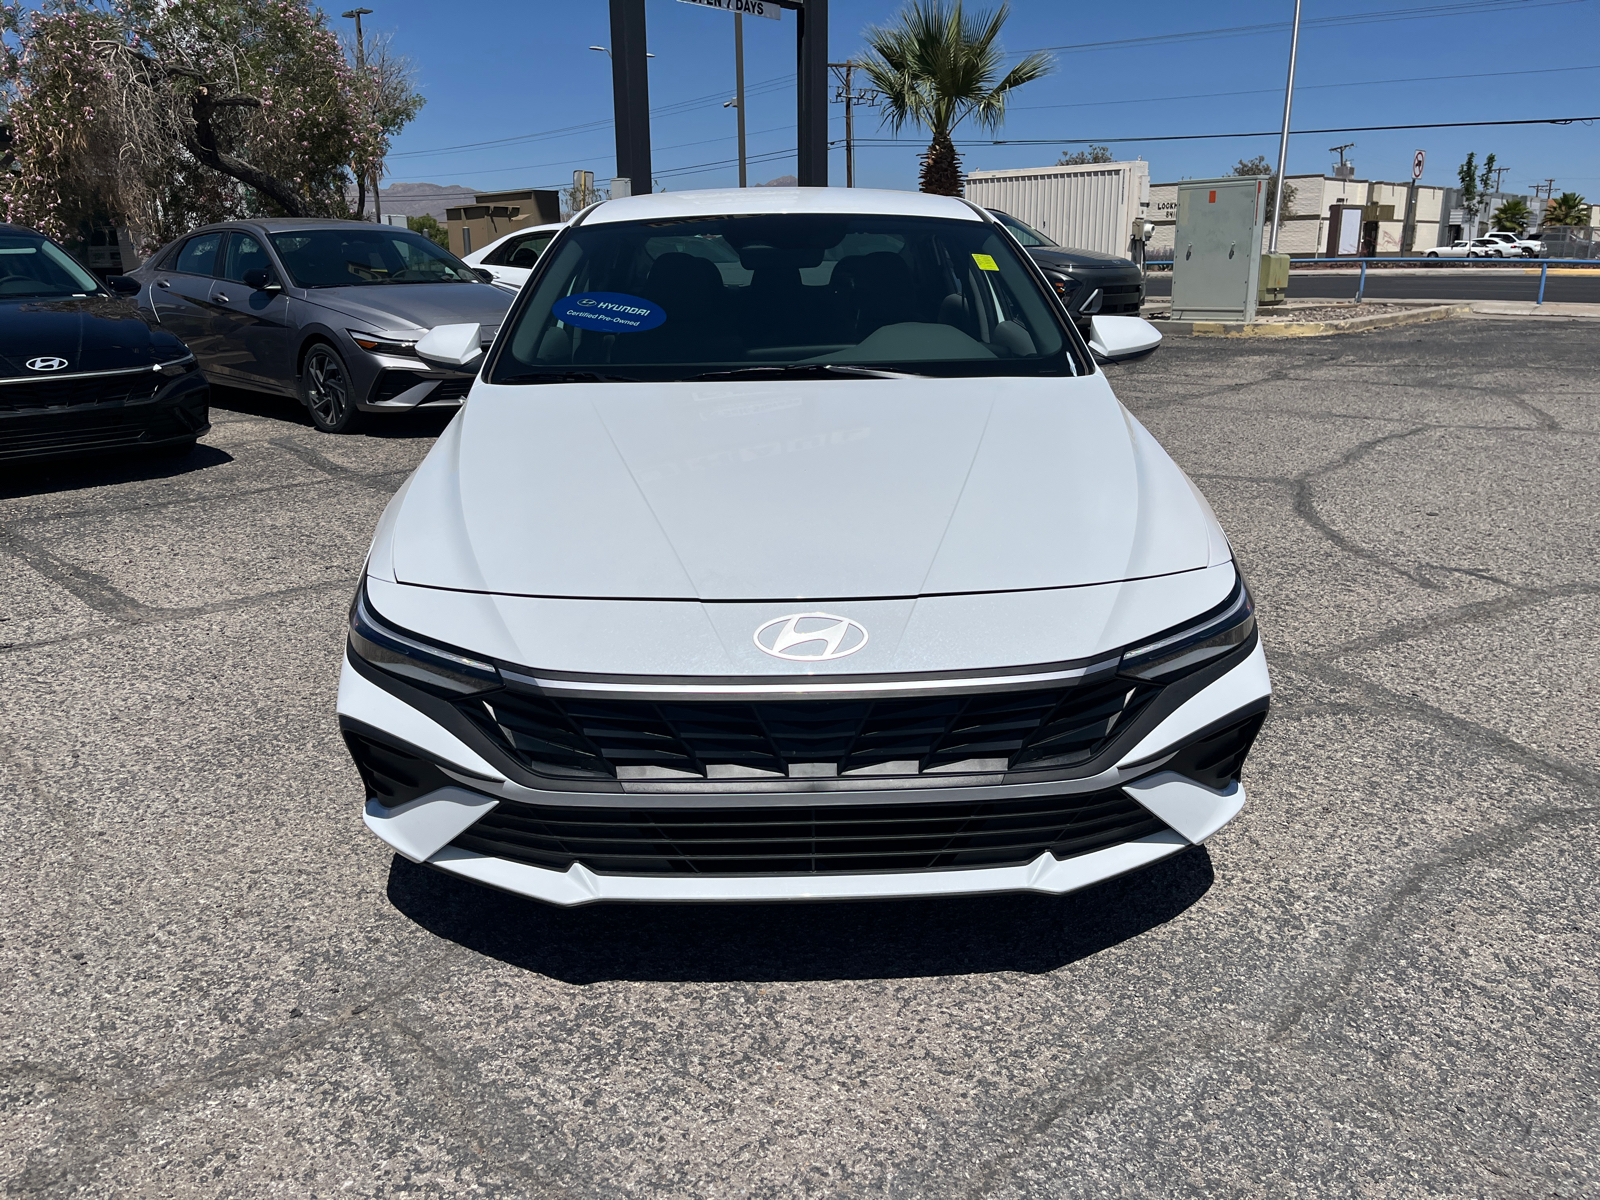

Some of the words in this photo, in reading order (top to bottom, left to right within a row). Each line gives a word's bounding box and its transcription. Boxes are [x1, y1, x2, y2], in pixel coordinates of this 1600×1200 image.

[736, 0, 764, 15] DAYS
[597, 301, 651, 317] HYUNDAI
[566, 309, 599, 319] Certified
[598, 314, 641, 327] Pre-Owned
